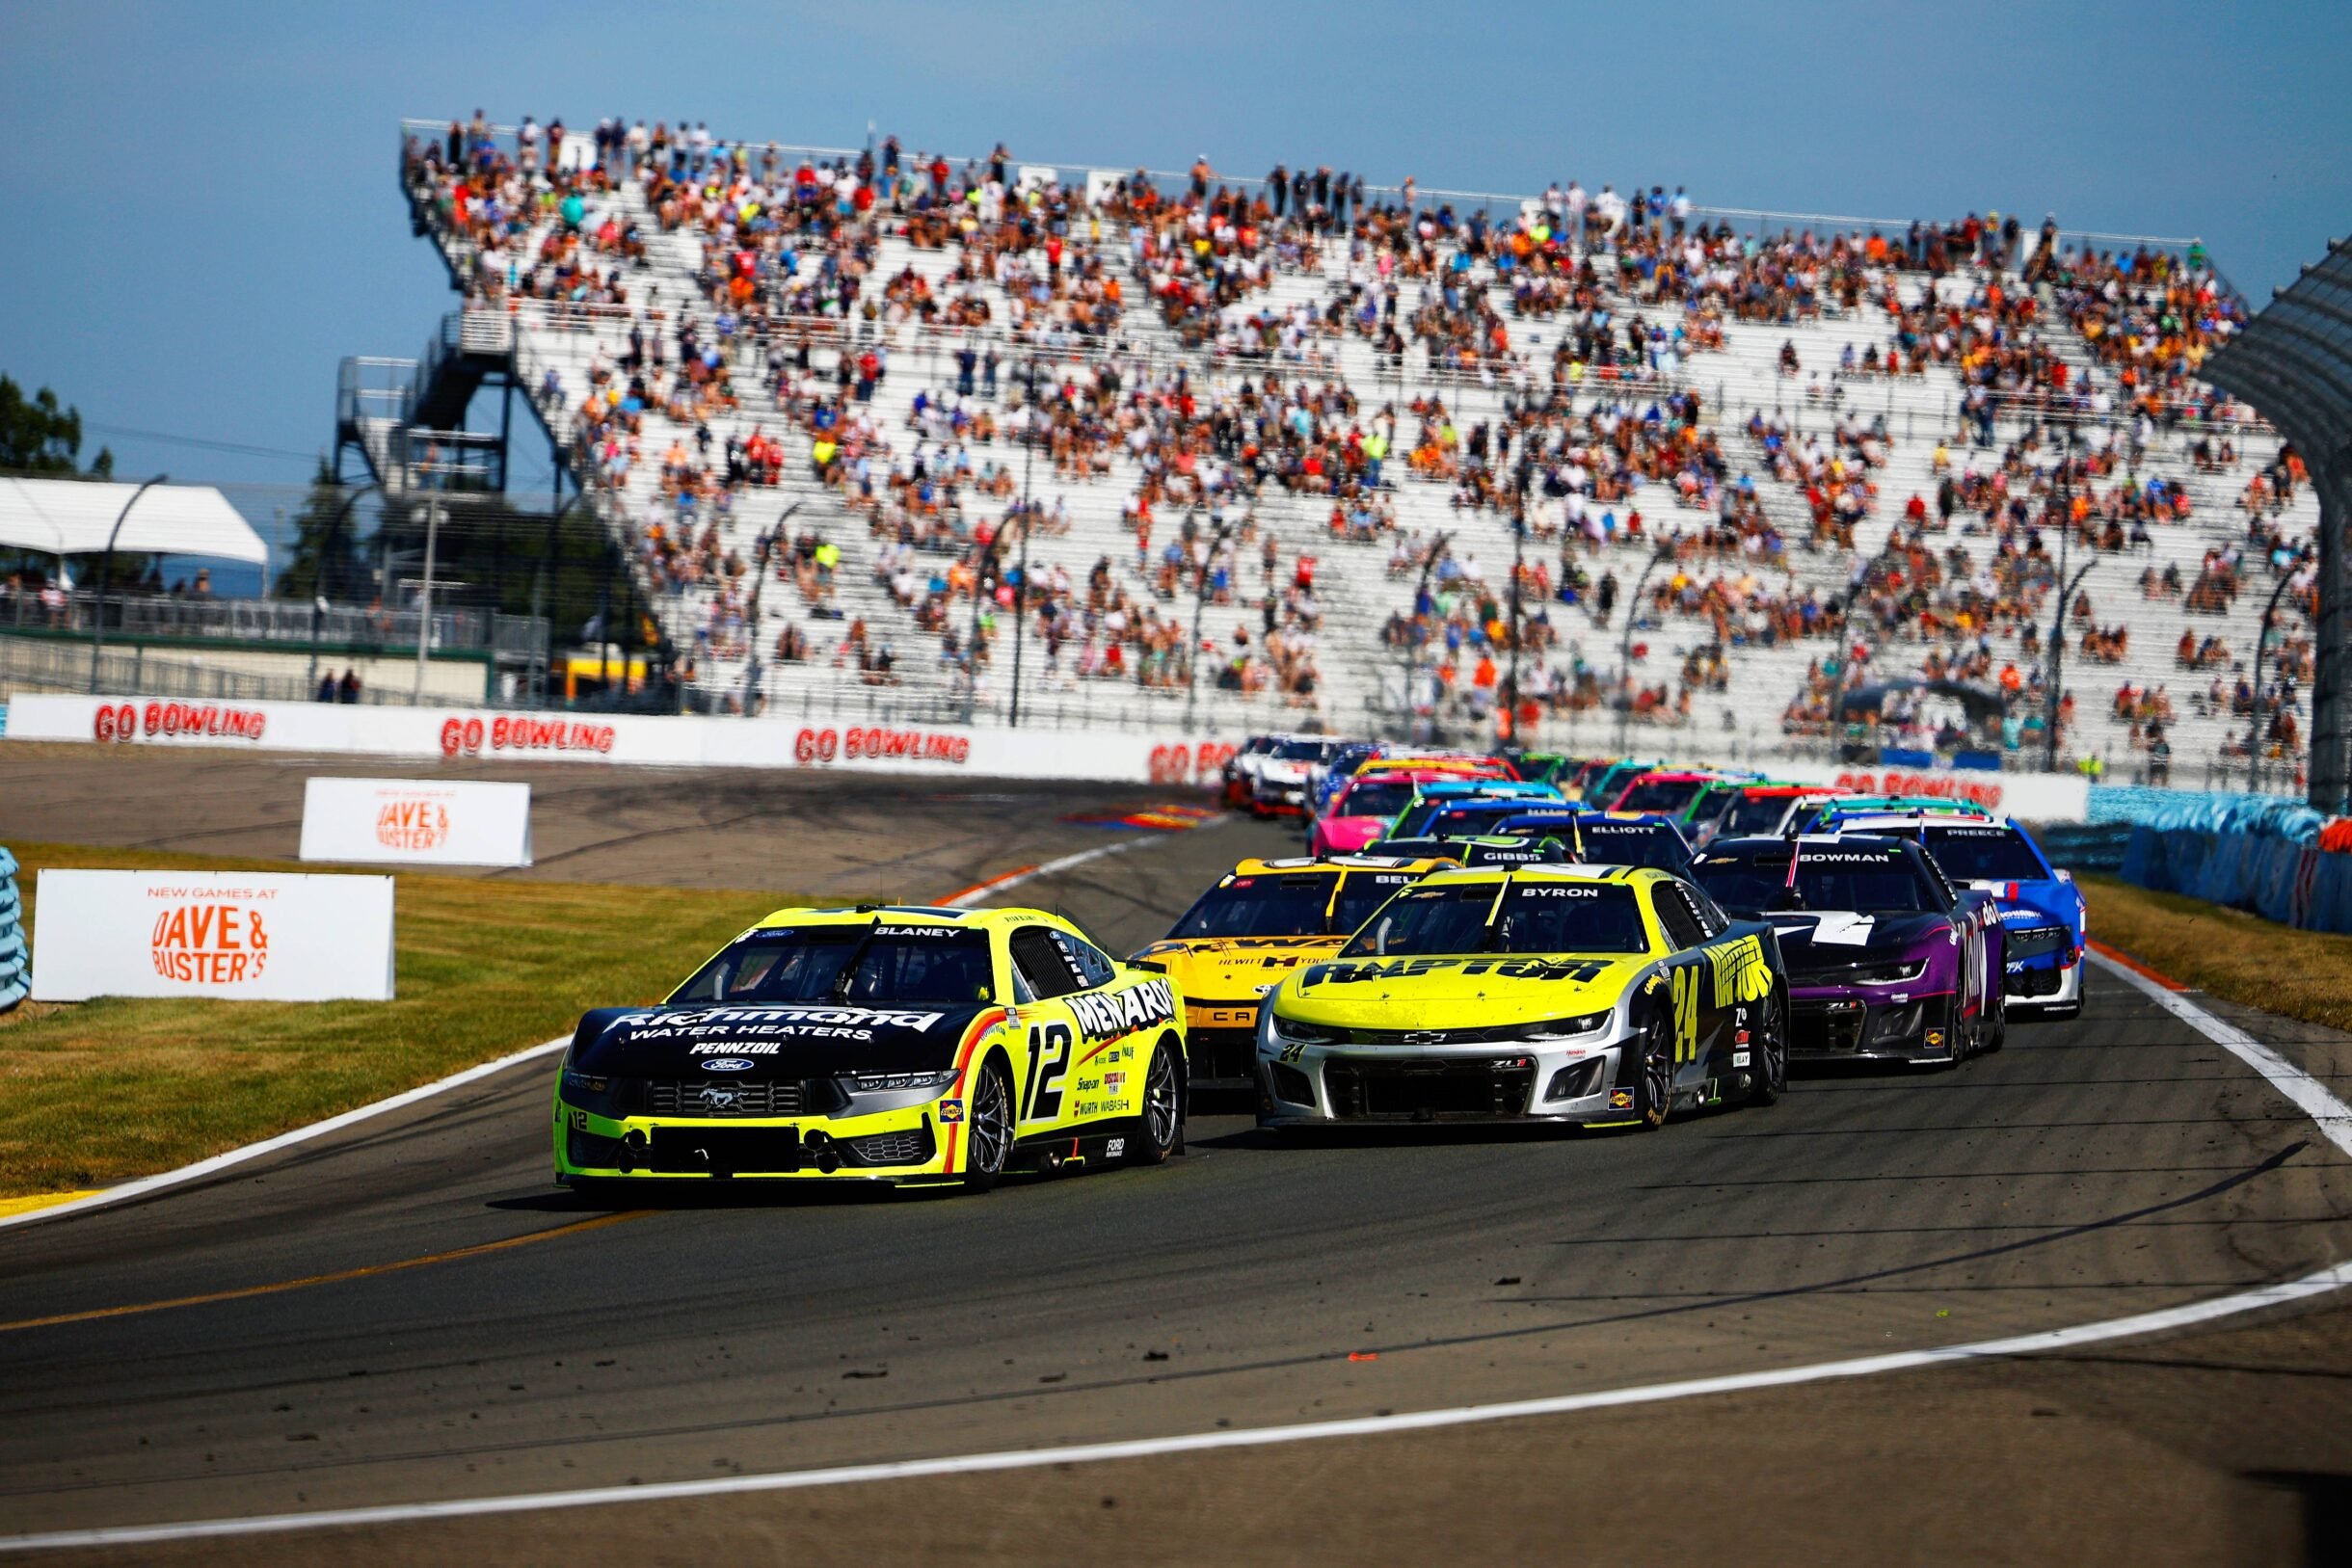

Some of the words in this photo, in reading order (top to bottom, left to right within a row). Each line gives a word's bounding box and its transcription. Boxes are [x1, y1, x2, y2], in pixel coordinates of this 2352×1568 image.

[94, 703, 137, 741] GO
[145, 700, 266, 739] BOWLING
[441, 717, 484, 756] GO
[492, 716, 616, 754] BOWLING
[794, 728, 838, 762] GO
[845, 727, 970, 763] BOWLING
[1591, 826, 1656, 835] ELLIOTT
[1483, 853, 1541, 862] GIBBS
[1799, 854, 1889, 863] BOWMAN
[147, 887, 188, 897] NEW
[192, 888, 254, 899] GAMES
[256, 889, 279, 899] AT
[1521, 888, 1599, 897] BYRON
[152, 904, 241, 949] DAVE
[250, 910, 269, 950] &
[874, 926, 961, 938] BLANEY
[152, 949, 268, 983] BUSTER'S
[1672, 965, 1699, 1063] 24
[629, 1025, 729, 1041] WATER
[735, 1024, 874, 1041] HEATERS
[689, 1042, 781, 1055] PENNZOIL
[1279, 1043, 1307, 1064] 24
[1019, 1023, 1073, 1122] 12
[1107, 1138, 1125, 1151] FORD
